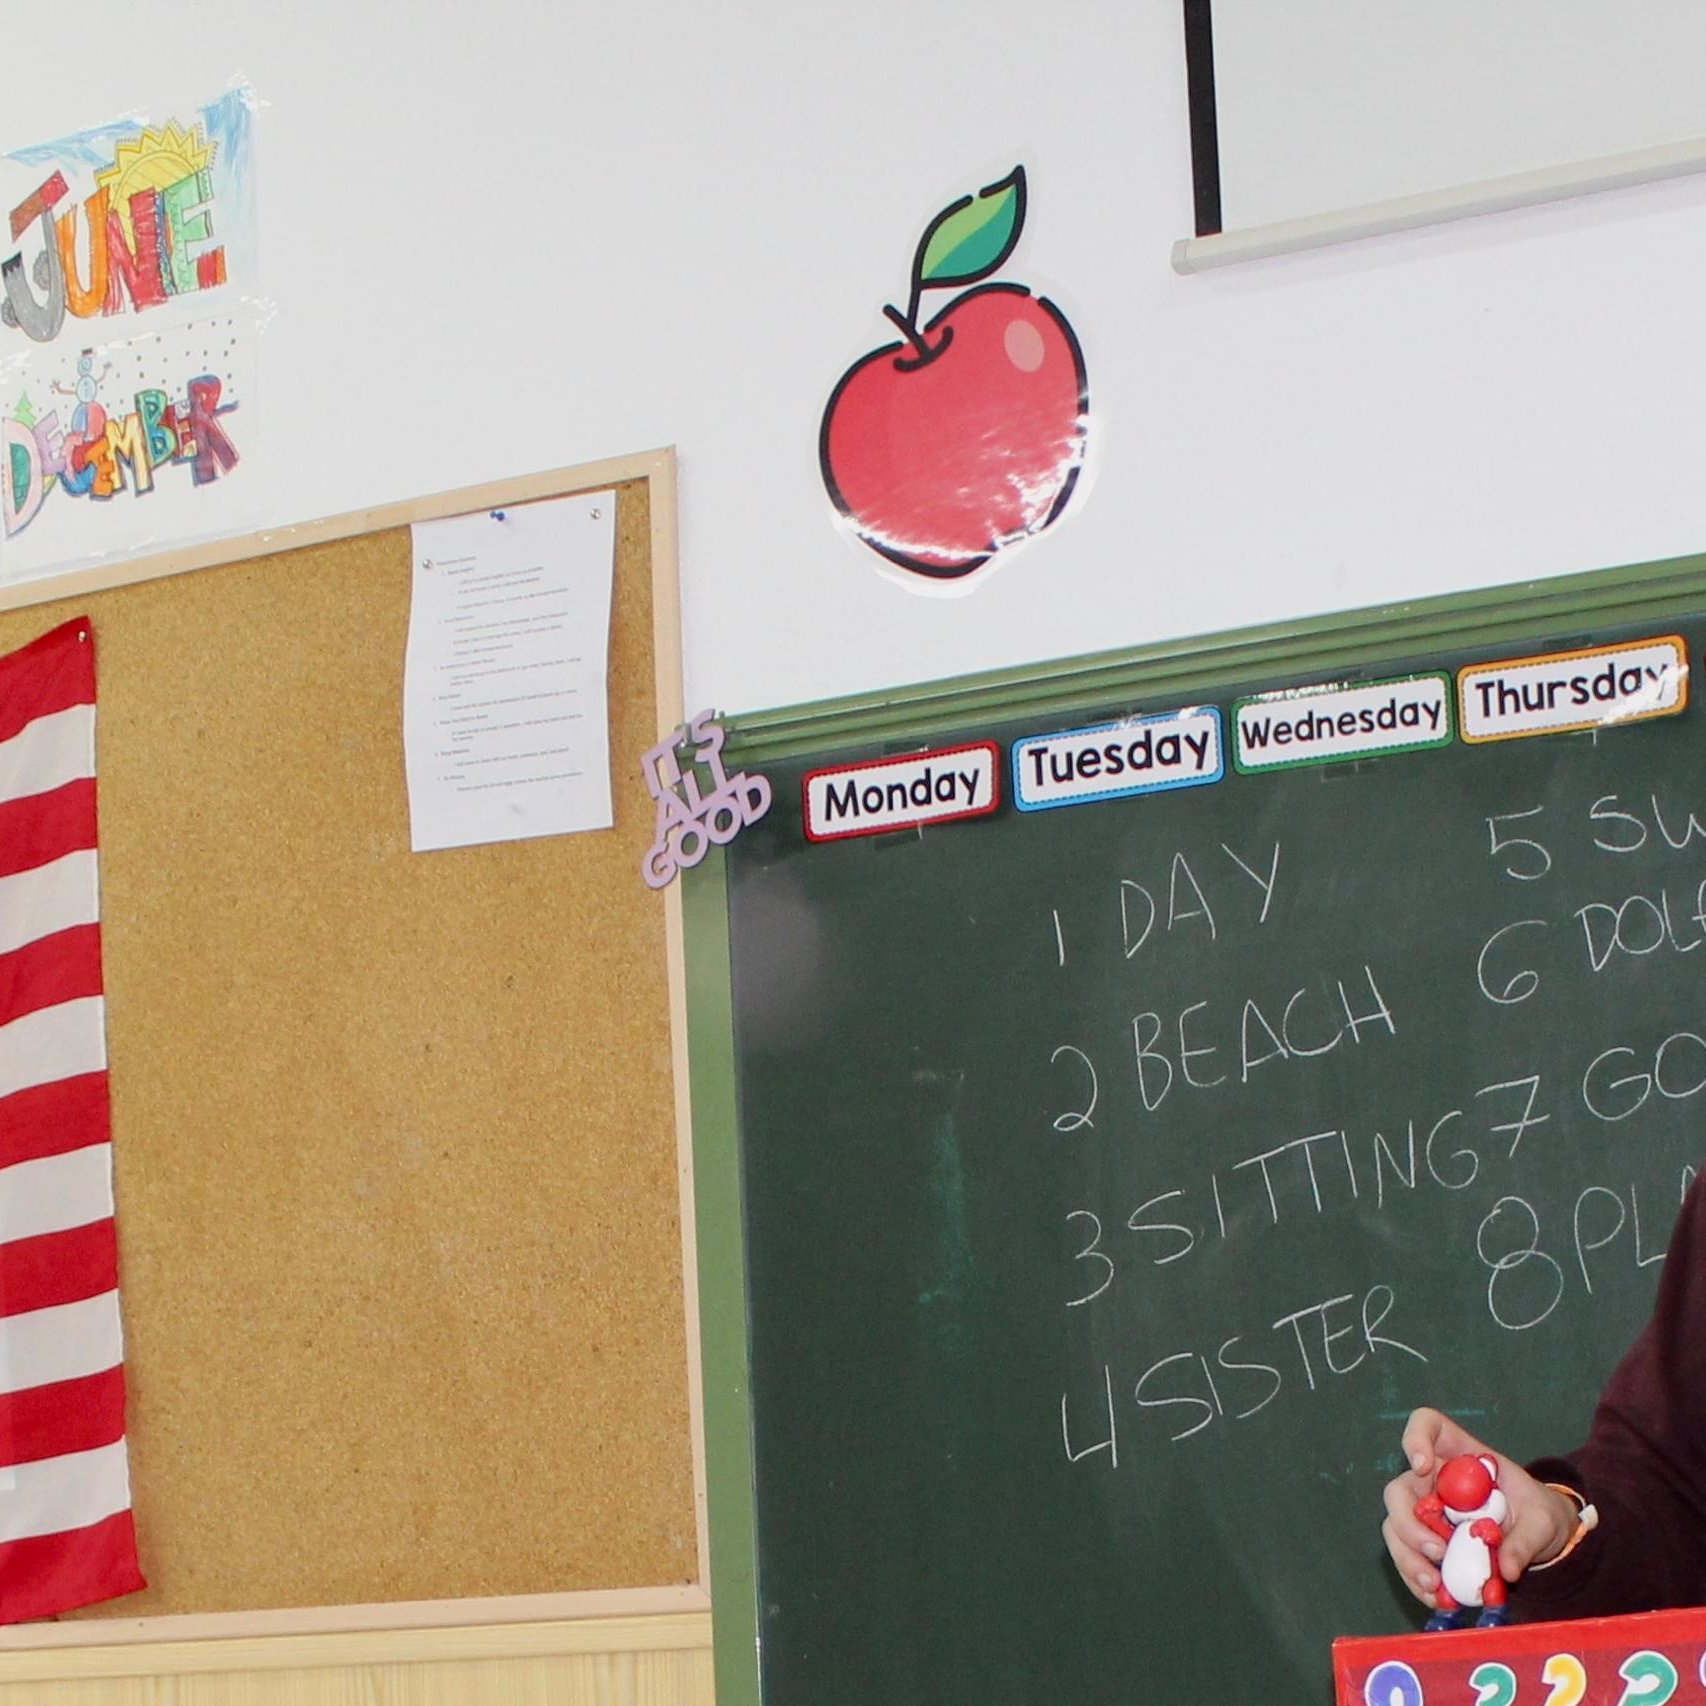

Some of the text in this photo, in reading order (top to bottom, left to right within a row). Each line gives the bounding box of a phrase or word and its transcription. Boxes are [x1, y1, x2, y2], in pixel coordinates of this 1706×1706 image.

[0, 168, 225, 342] JUNE
[1241, 697, 1442, 750] Wednesday
[1475, 662, 1668, 718] Thursday
[823, 767, 980, 823] Monday
[1028, 729, 1209, 786] Tuesday
[641, 773, 771, 888] GOOD
[1486, 806, 1551, 880] 5
[1120, 840, 1280, 959] DAY
[1477, 920, 1547, 1004] 6
[1051, 965, 1396, 1132] 2 BEACH
[1475, 1075, 1550, 1158] 7
[1477, 1196, 1563, 1330] 8
